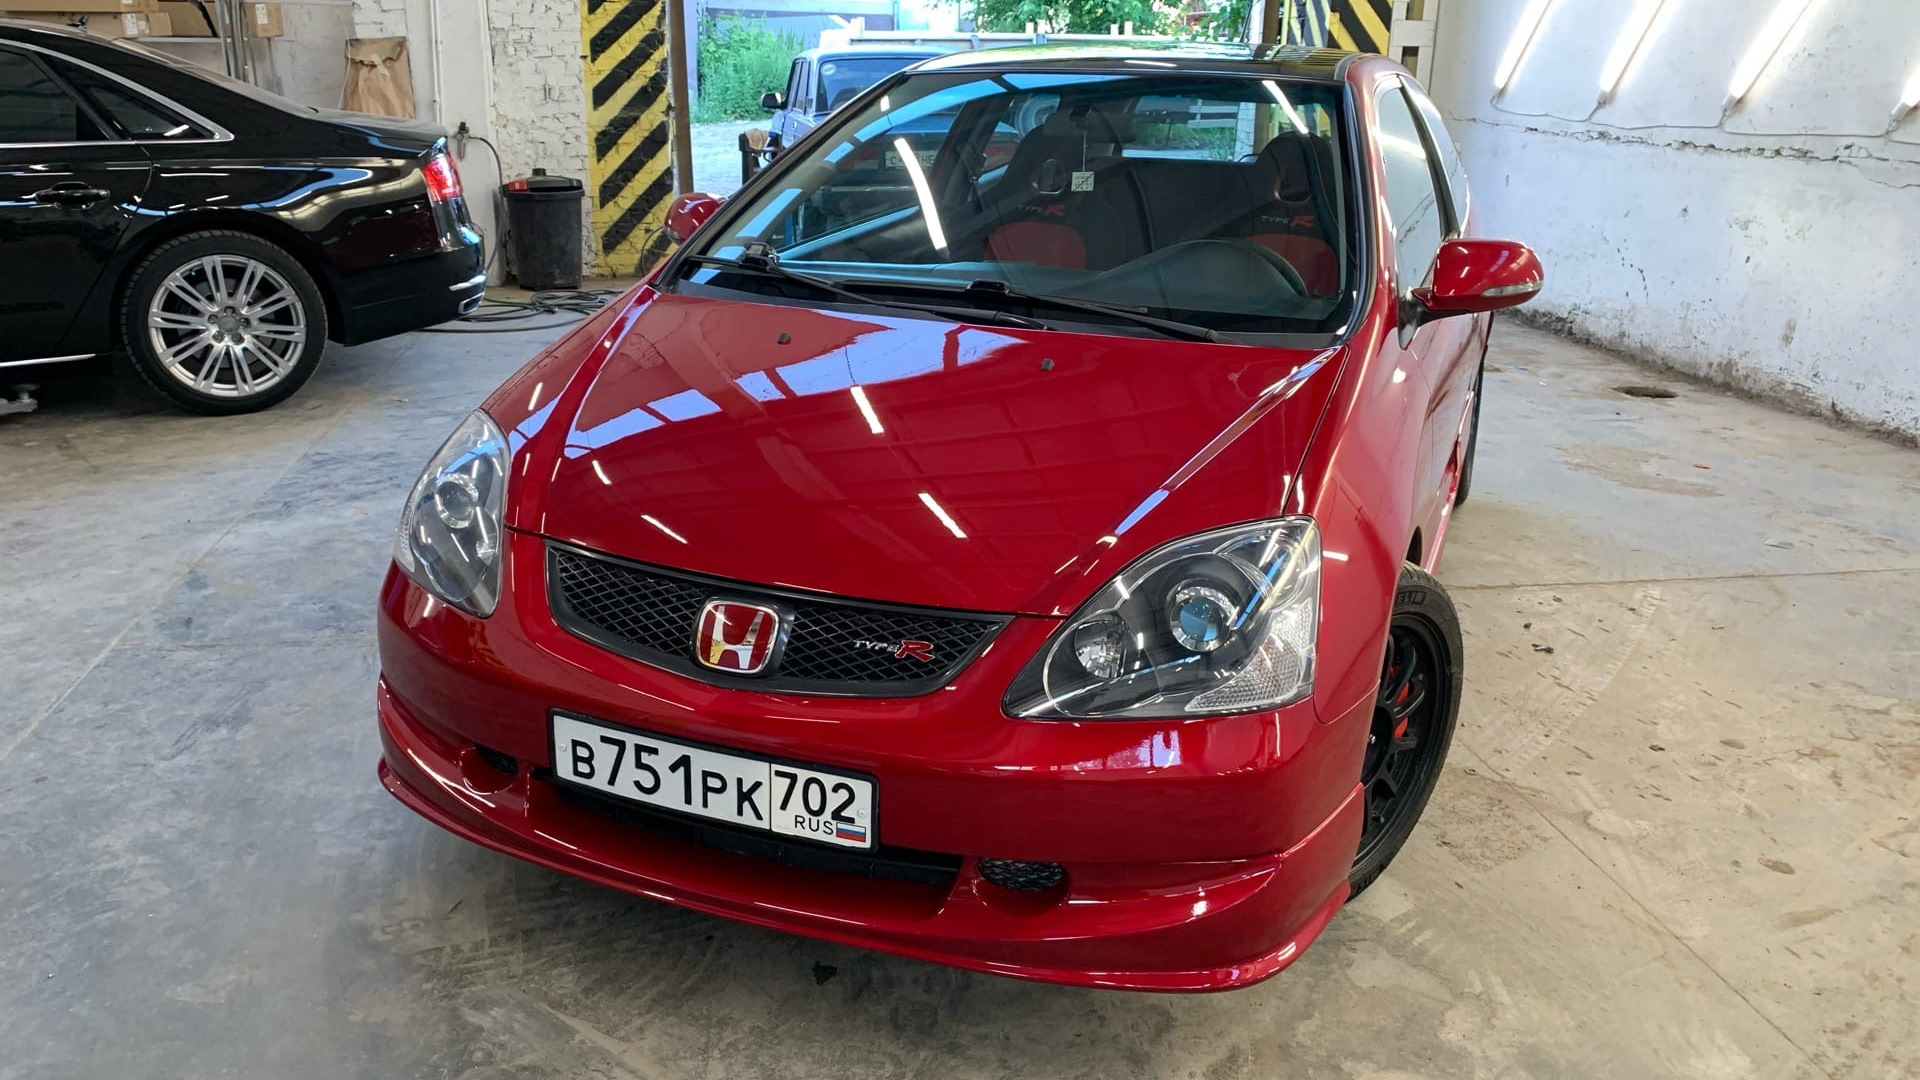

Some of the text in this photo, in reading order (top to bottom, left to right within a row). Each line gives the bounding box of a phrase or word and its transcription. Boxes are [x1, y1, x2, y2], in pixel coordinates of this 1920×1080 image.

[854, 639, 936, 663] TYPE R
[774, 769, 856, 824] 702
[794, 814, 834, 836] RUS
